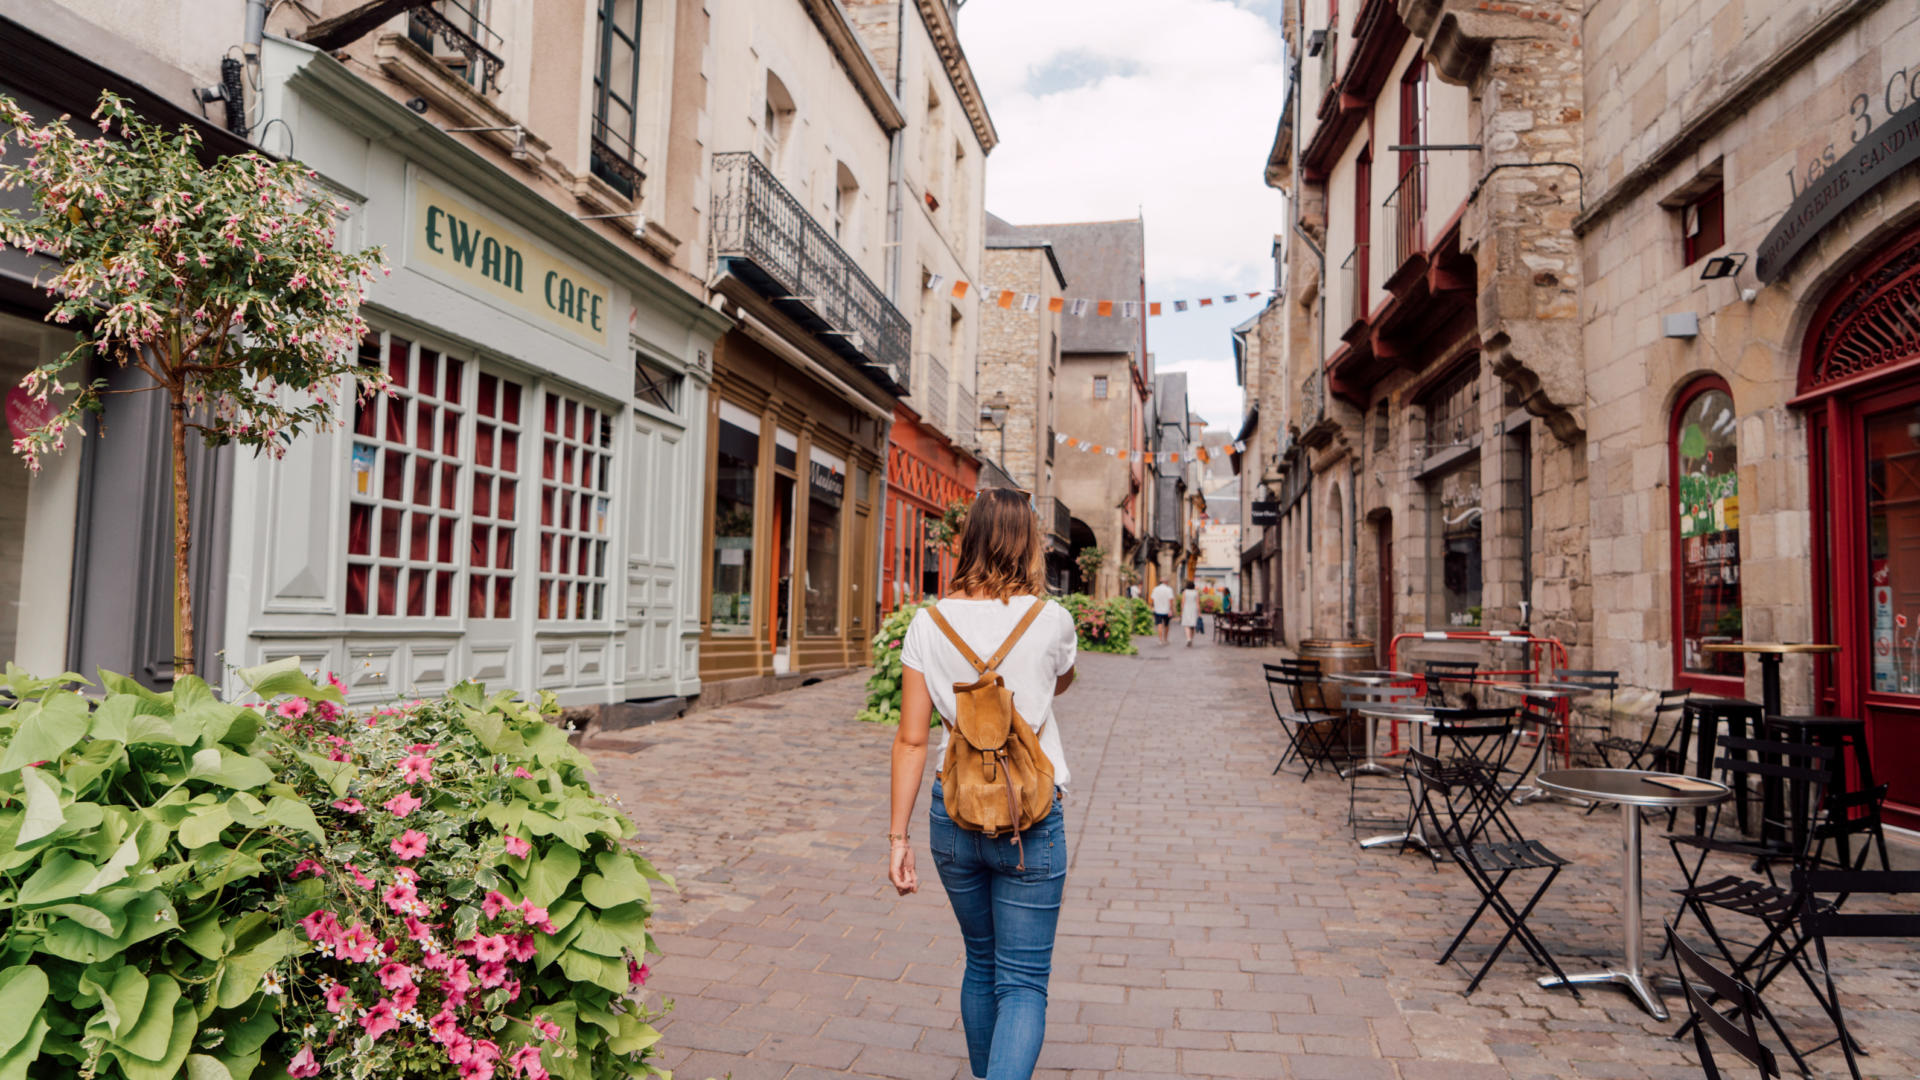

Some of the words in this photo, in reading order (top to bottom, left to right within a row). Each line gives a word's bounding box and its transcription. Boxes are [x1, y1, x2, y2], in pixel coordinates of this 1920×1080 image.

[1785, 143, 1837, 201] Les
[1850, 93, 1873, 144] 3
[425, 204, 524, 294] EWAN
[544, 270, 603, 333] CAFE
